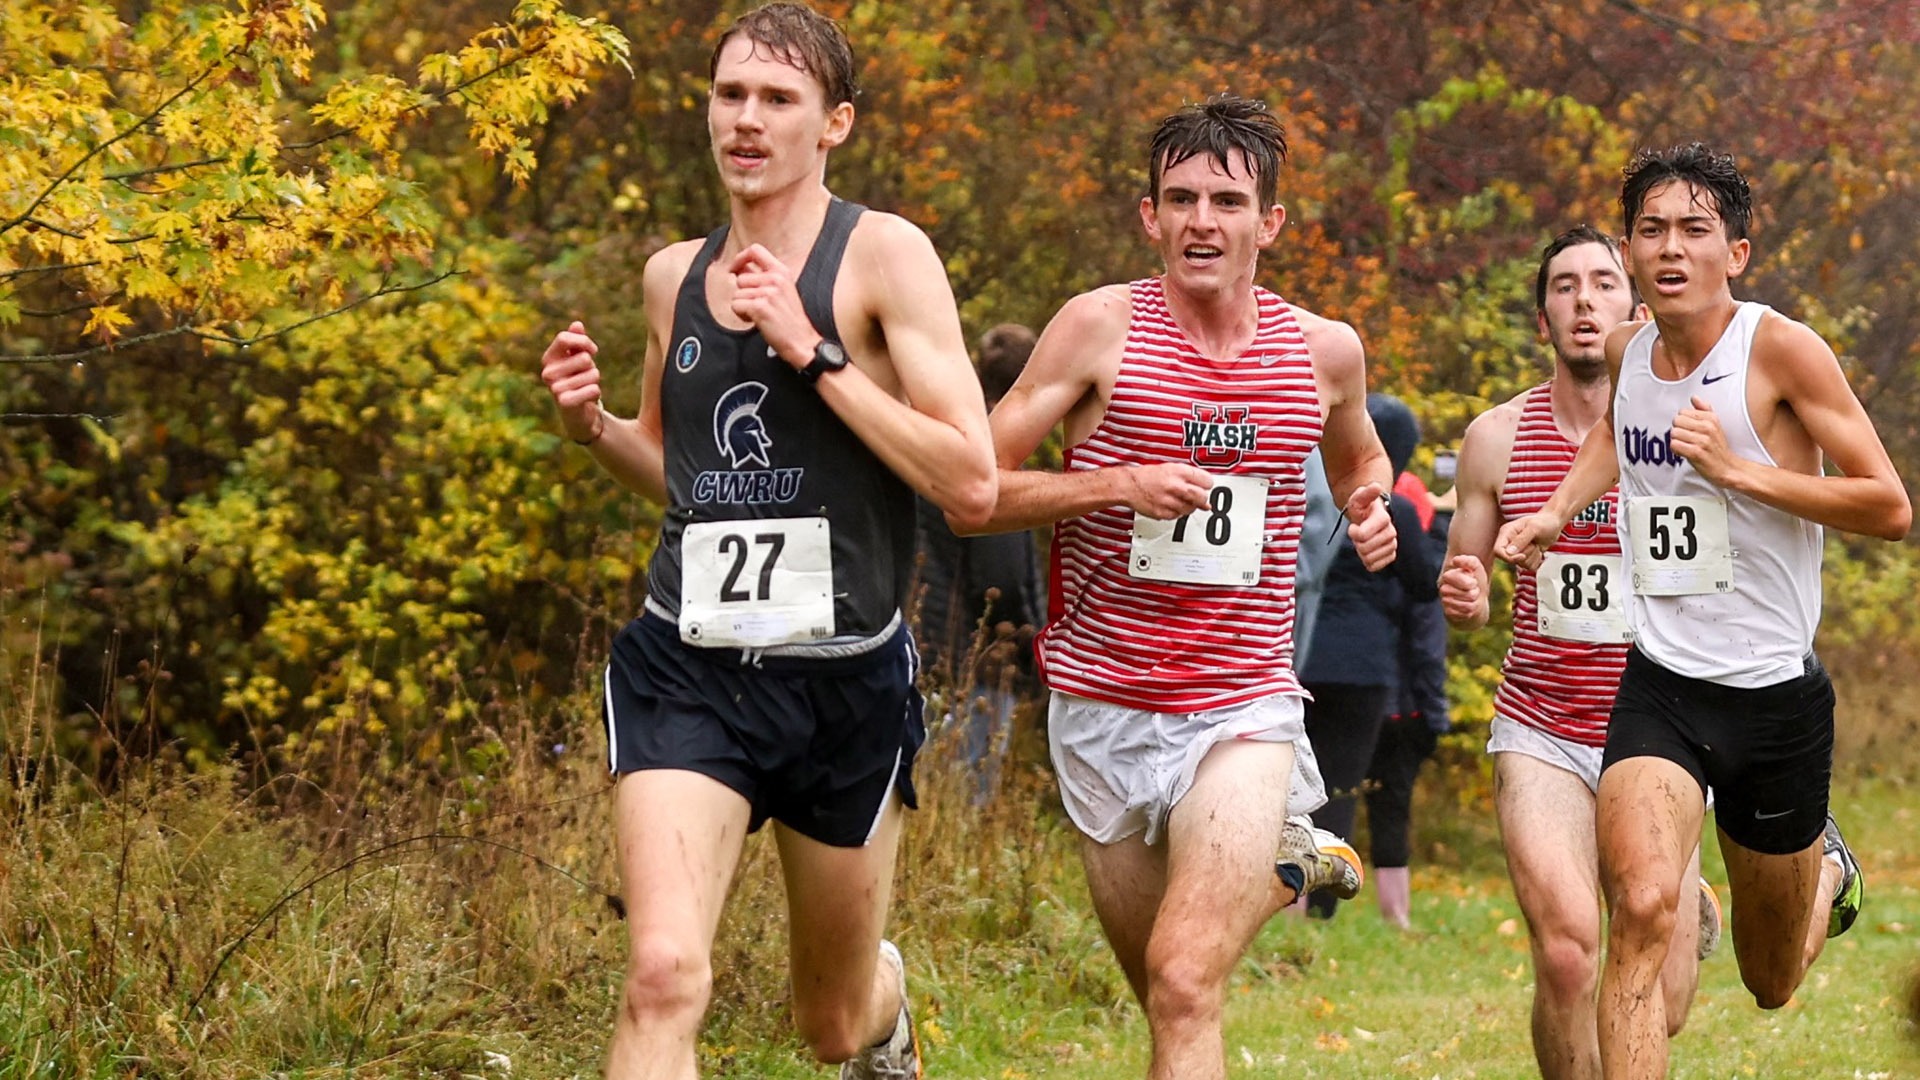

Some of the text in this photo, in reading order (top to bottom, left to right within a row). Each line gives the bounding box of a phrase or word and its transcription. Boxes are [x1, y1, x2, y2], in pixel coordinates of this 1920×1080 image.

[1183, 420, 1257, 451] WASH
[1622, 424, 1684, 467] Viol
[692, 467, 803, 504] CWRU
[1649, 506, 1698, 561] 53
[718, 533, 785, 603] 27
[1560, 563, 1609, 612] 83
